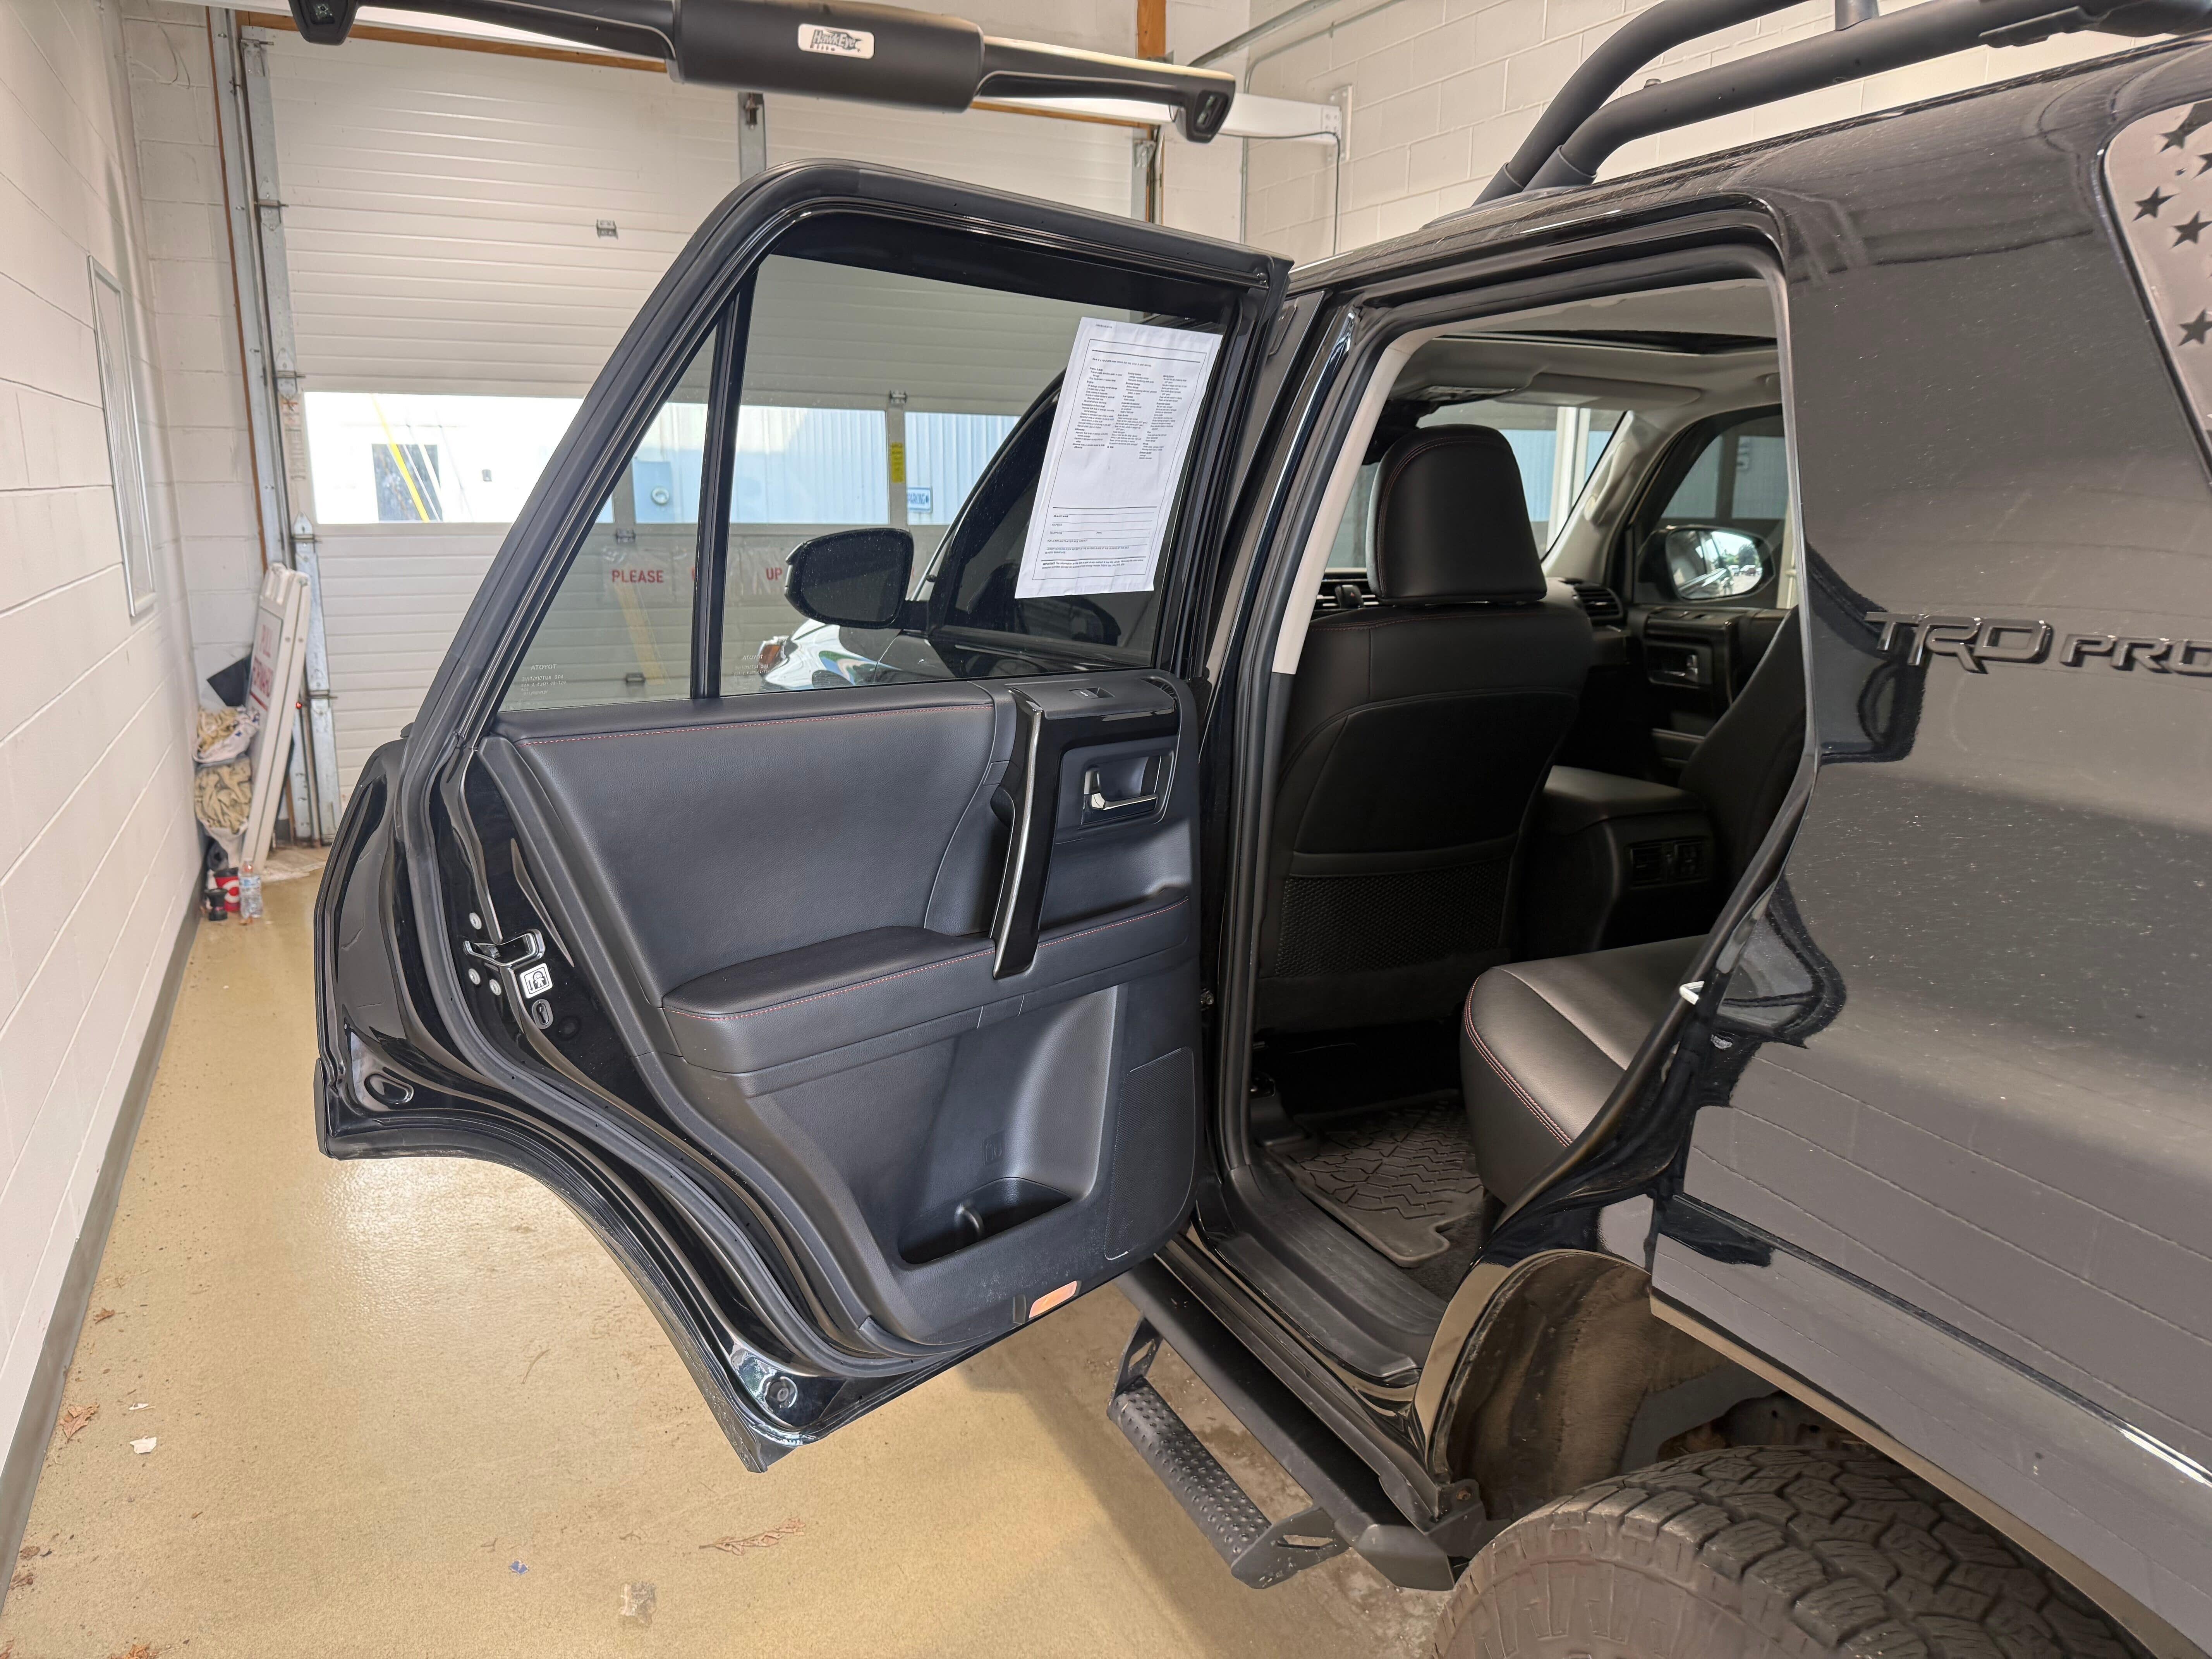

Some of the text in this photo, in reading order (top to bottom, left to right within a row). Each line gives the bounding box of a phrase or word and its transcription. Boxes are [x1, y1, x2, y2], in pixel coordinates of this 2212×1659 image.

[612, 567, 783, 583] PLEASE UP
[1863, 611, 2212, 677] TRD PRO
